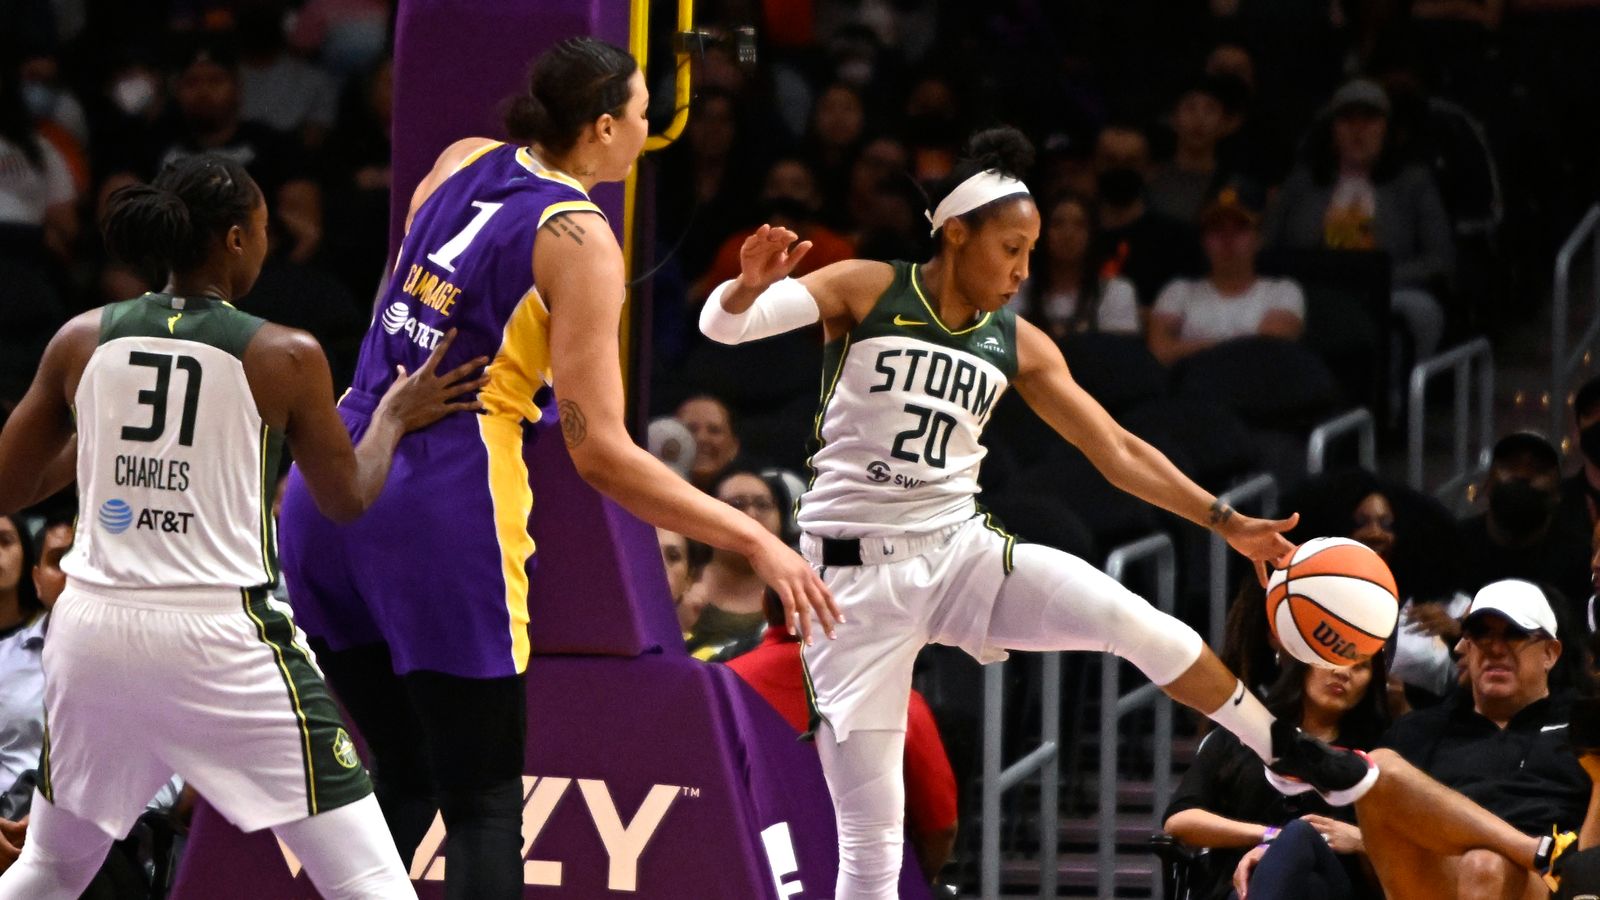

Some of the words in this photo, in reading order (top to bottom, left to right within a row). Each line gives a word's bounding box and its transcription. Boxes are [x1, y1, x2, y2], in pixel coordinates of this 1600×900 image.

[427, 201, 503, 272] 1
[405, 317, 445, 351] AT&T
[120, 351, 203, 447] 31
[869, 349, 998, 426] STORM
[890, 403, 958, 469] 20
[115, 455, 190, 492] CHARLES
[136, 508, 194, 534] AT&T
